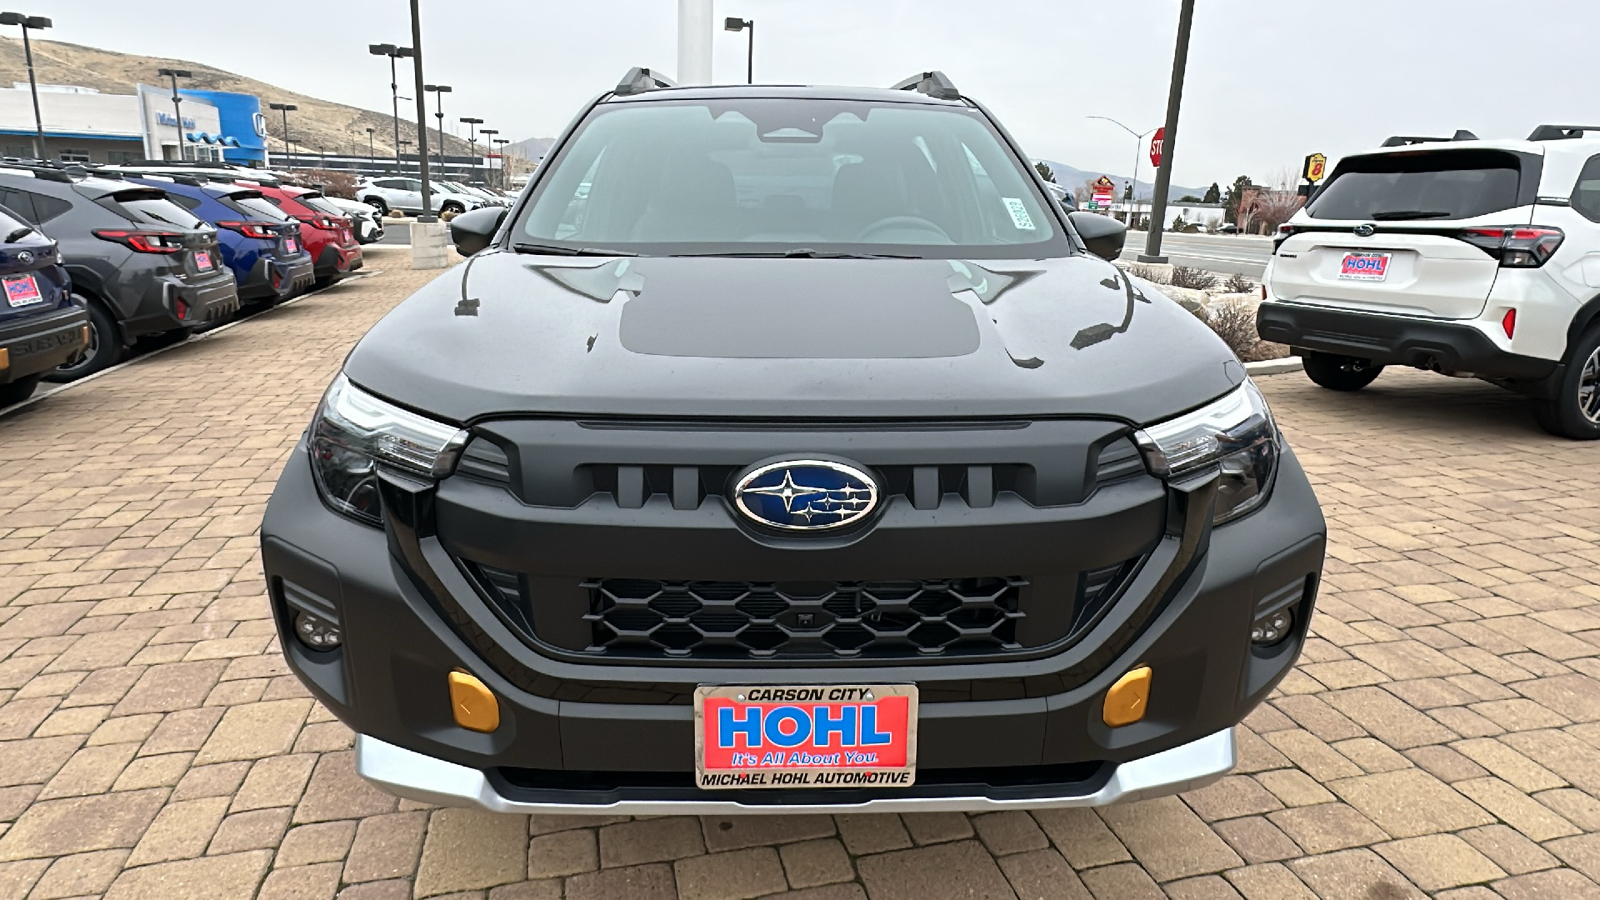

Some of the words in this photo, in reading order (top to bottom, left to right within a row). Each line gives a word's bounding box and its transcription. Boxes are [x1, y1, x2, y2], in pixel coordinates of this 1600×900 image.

[1311, 163, 1323, 176] 8
[1346, 258, 1383, 271] HOHL
[748, 688, 825, 701] CARSON
[828, 688, 870, 701] CITY
[718, 705, 892, 748] HOHL
[731, 752, 757, 766] It's
[761, 752, 786, 765] All
[788, 751, 840, 765] About
[844, 751, 879, 764] You.
[702, 773, 767, 785] MICHAEL
[771, 772, 810, 784] HOHL
[813, 772, 910, 784] AUTOMOTIVE
